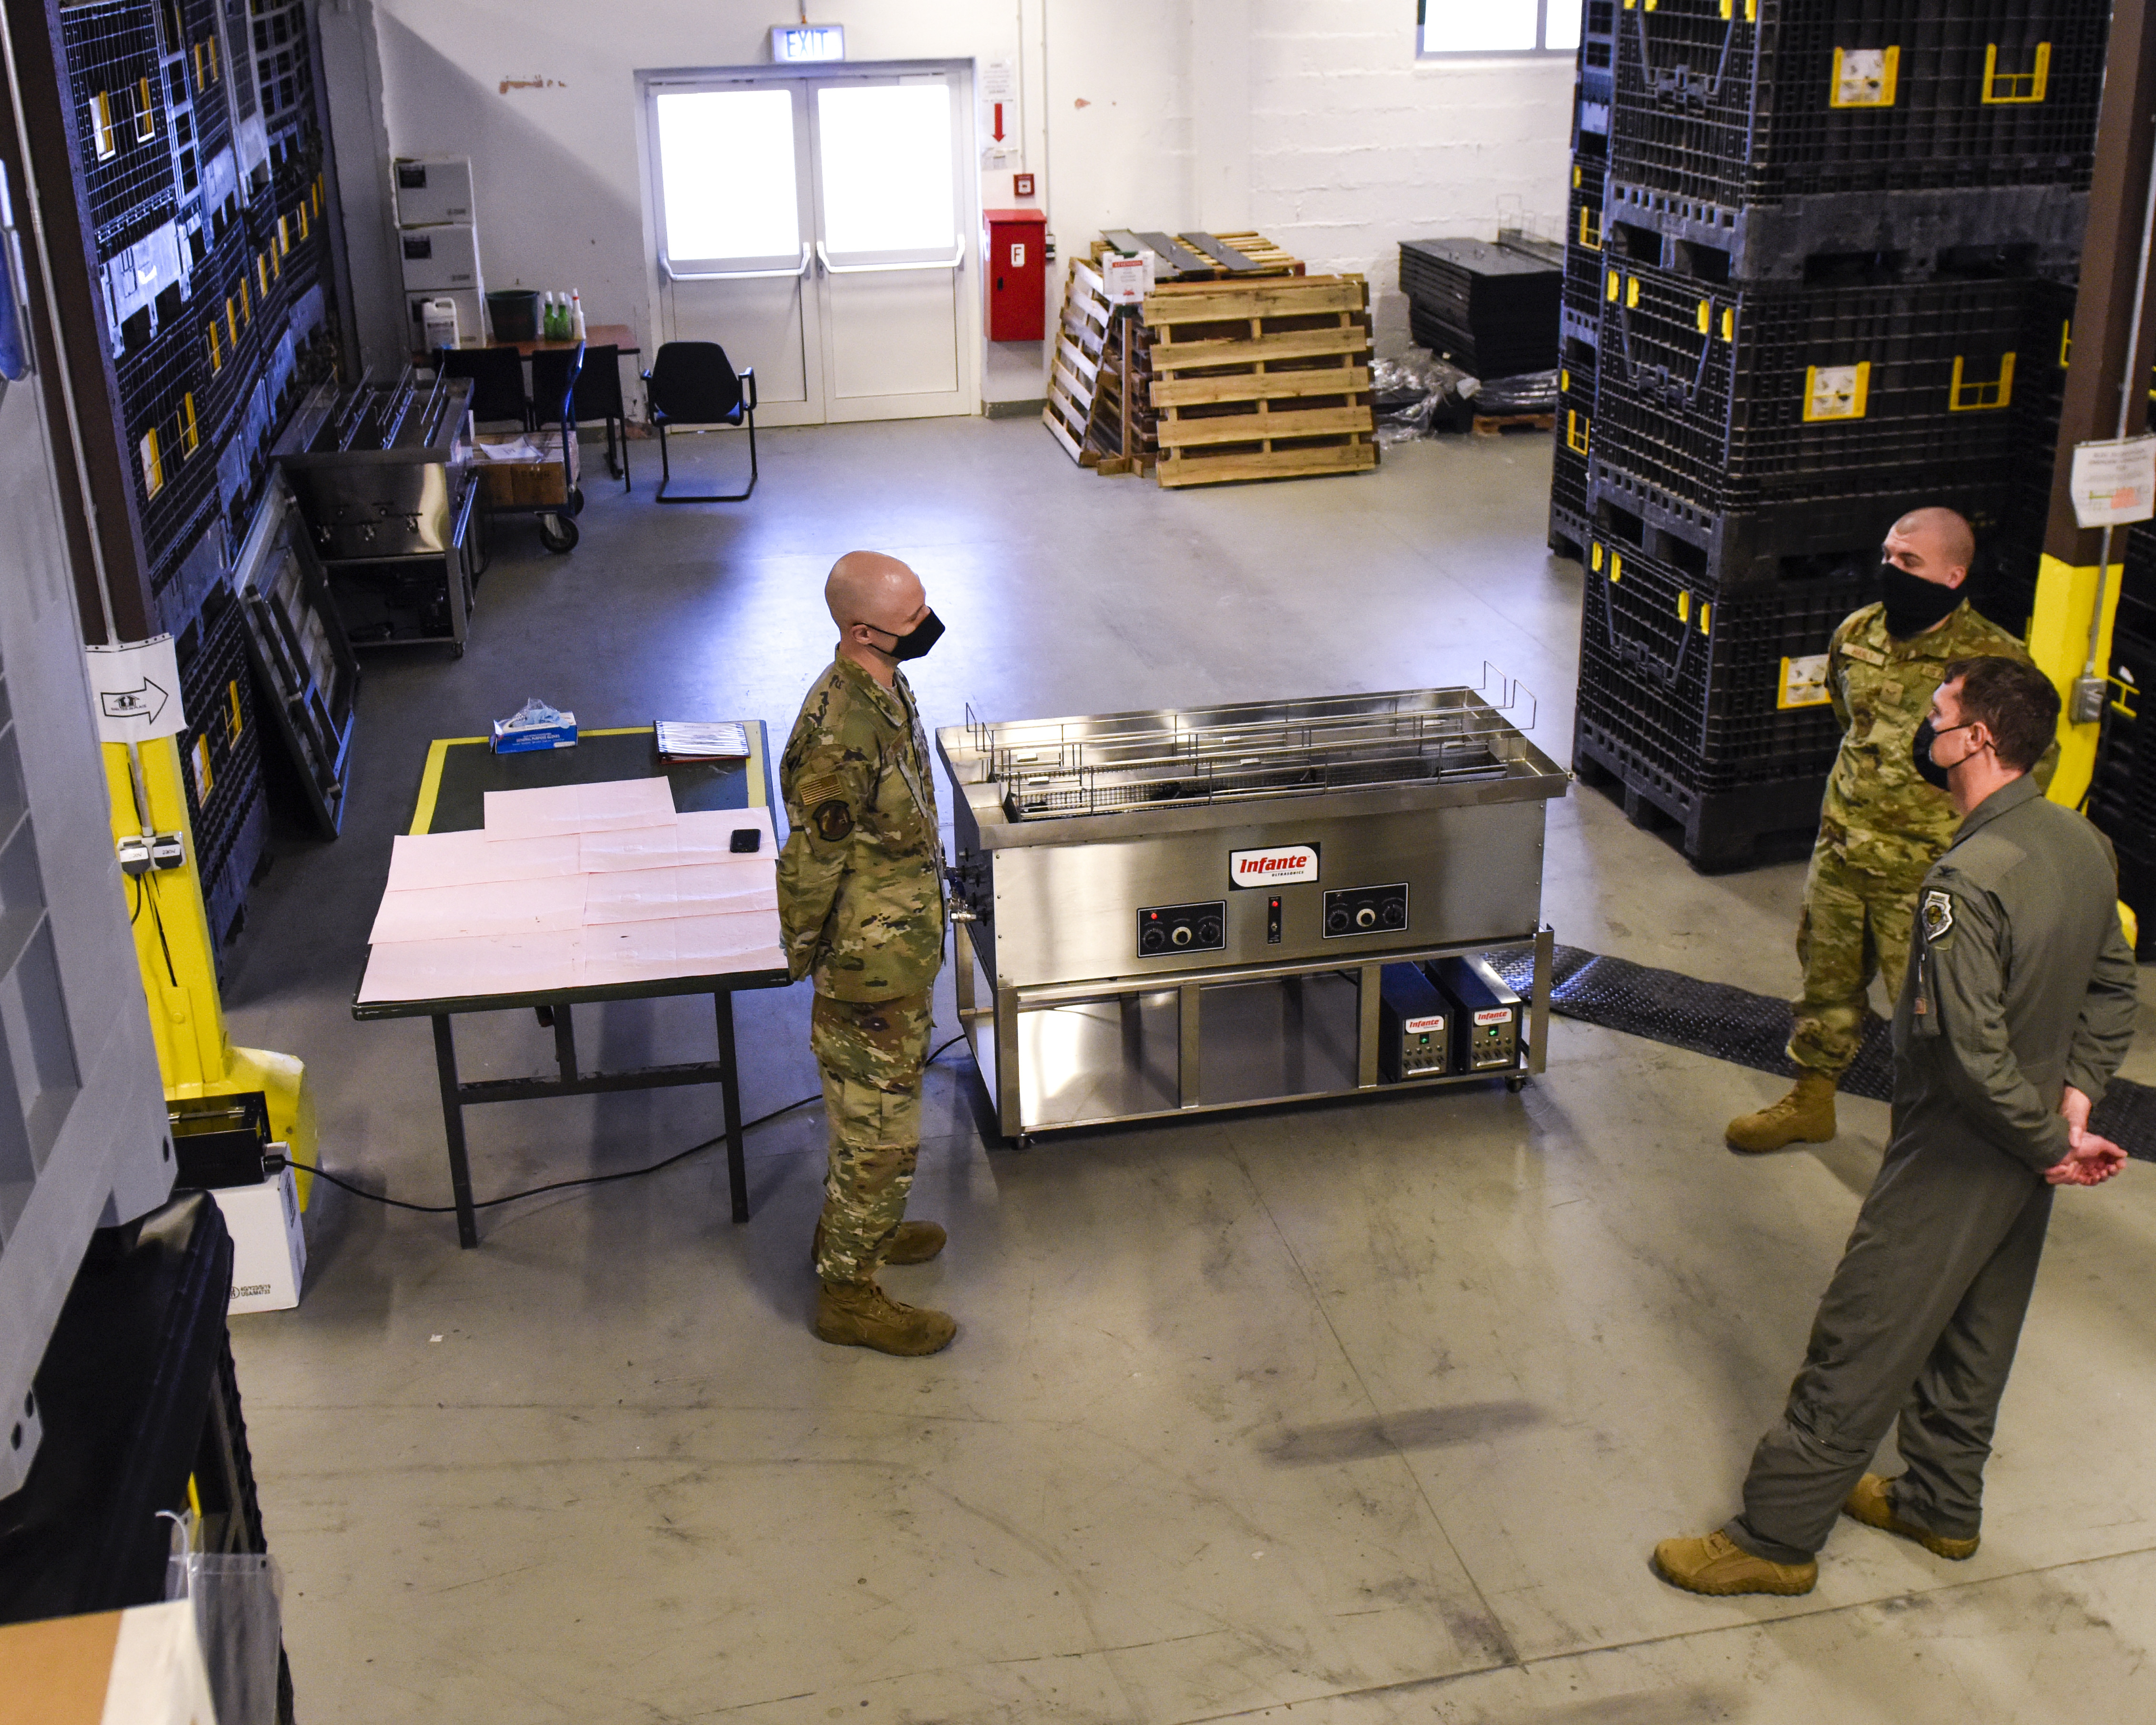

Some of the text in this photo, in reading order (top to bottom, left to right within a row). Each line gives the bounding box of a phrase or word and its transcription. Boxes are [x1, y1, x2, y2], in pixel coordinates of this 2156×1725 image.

[786, 29, 828, 57] EXIT
[1014, 247, 1021, 262] F
[1239, 855, 1307, 874] Infante
[1478, 1011, 1508, 1020] Infante
[1409, 1019, 1439, 1028] Infante
